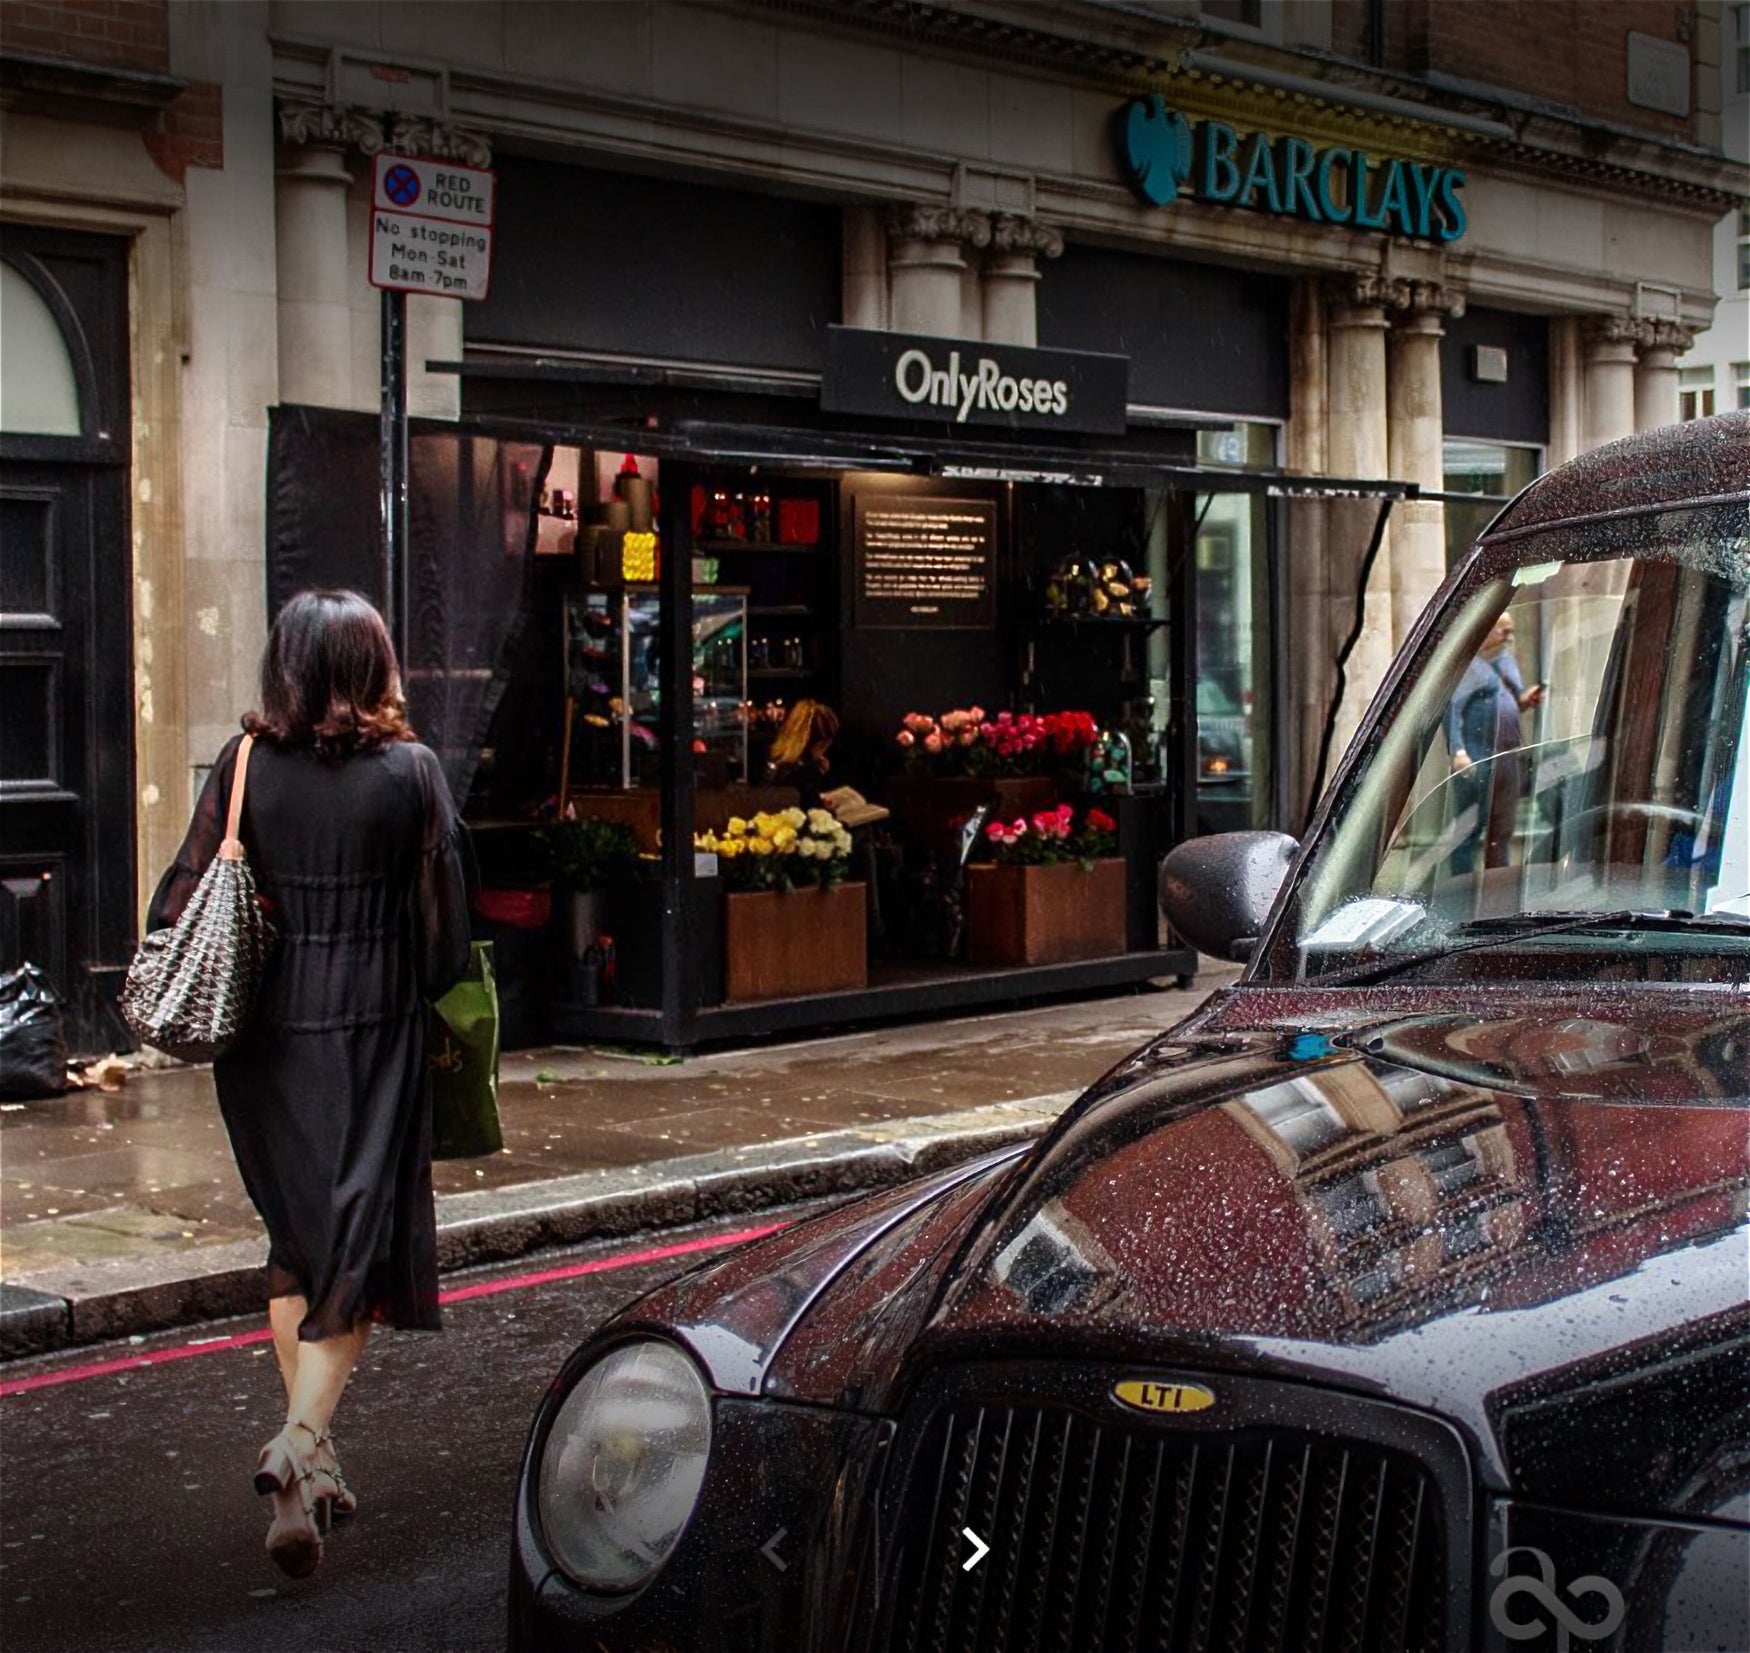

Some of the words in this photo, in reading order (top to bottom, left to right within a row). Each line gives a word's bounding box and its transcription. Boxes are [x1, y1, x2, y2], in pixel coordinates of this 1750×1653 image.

[435, 172, 471, 193] RED
[1200, 119, 1467, 242] BARCLAYS
[427, 188, 485, 214] ROUTE
[375, 217, 400, 235] No
[410, 225, 486, 253] stopping
[391, 242, 428, 263] Mon
[437, 250, 466, 270] Sat
[895, 349, 1068, 423] OnlyRoses
[1140, 1384, 1183, 1409] LTI
